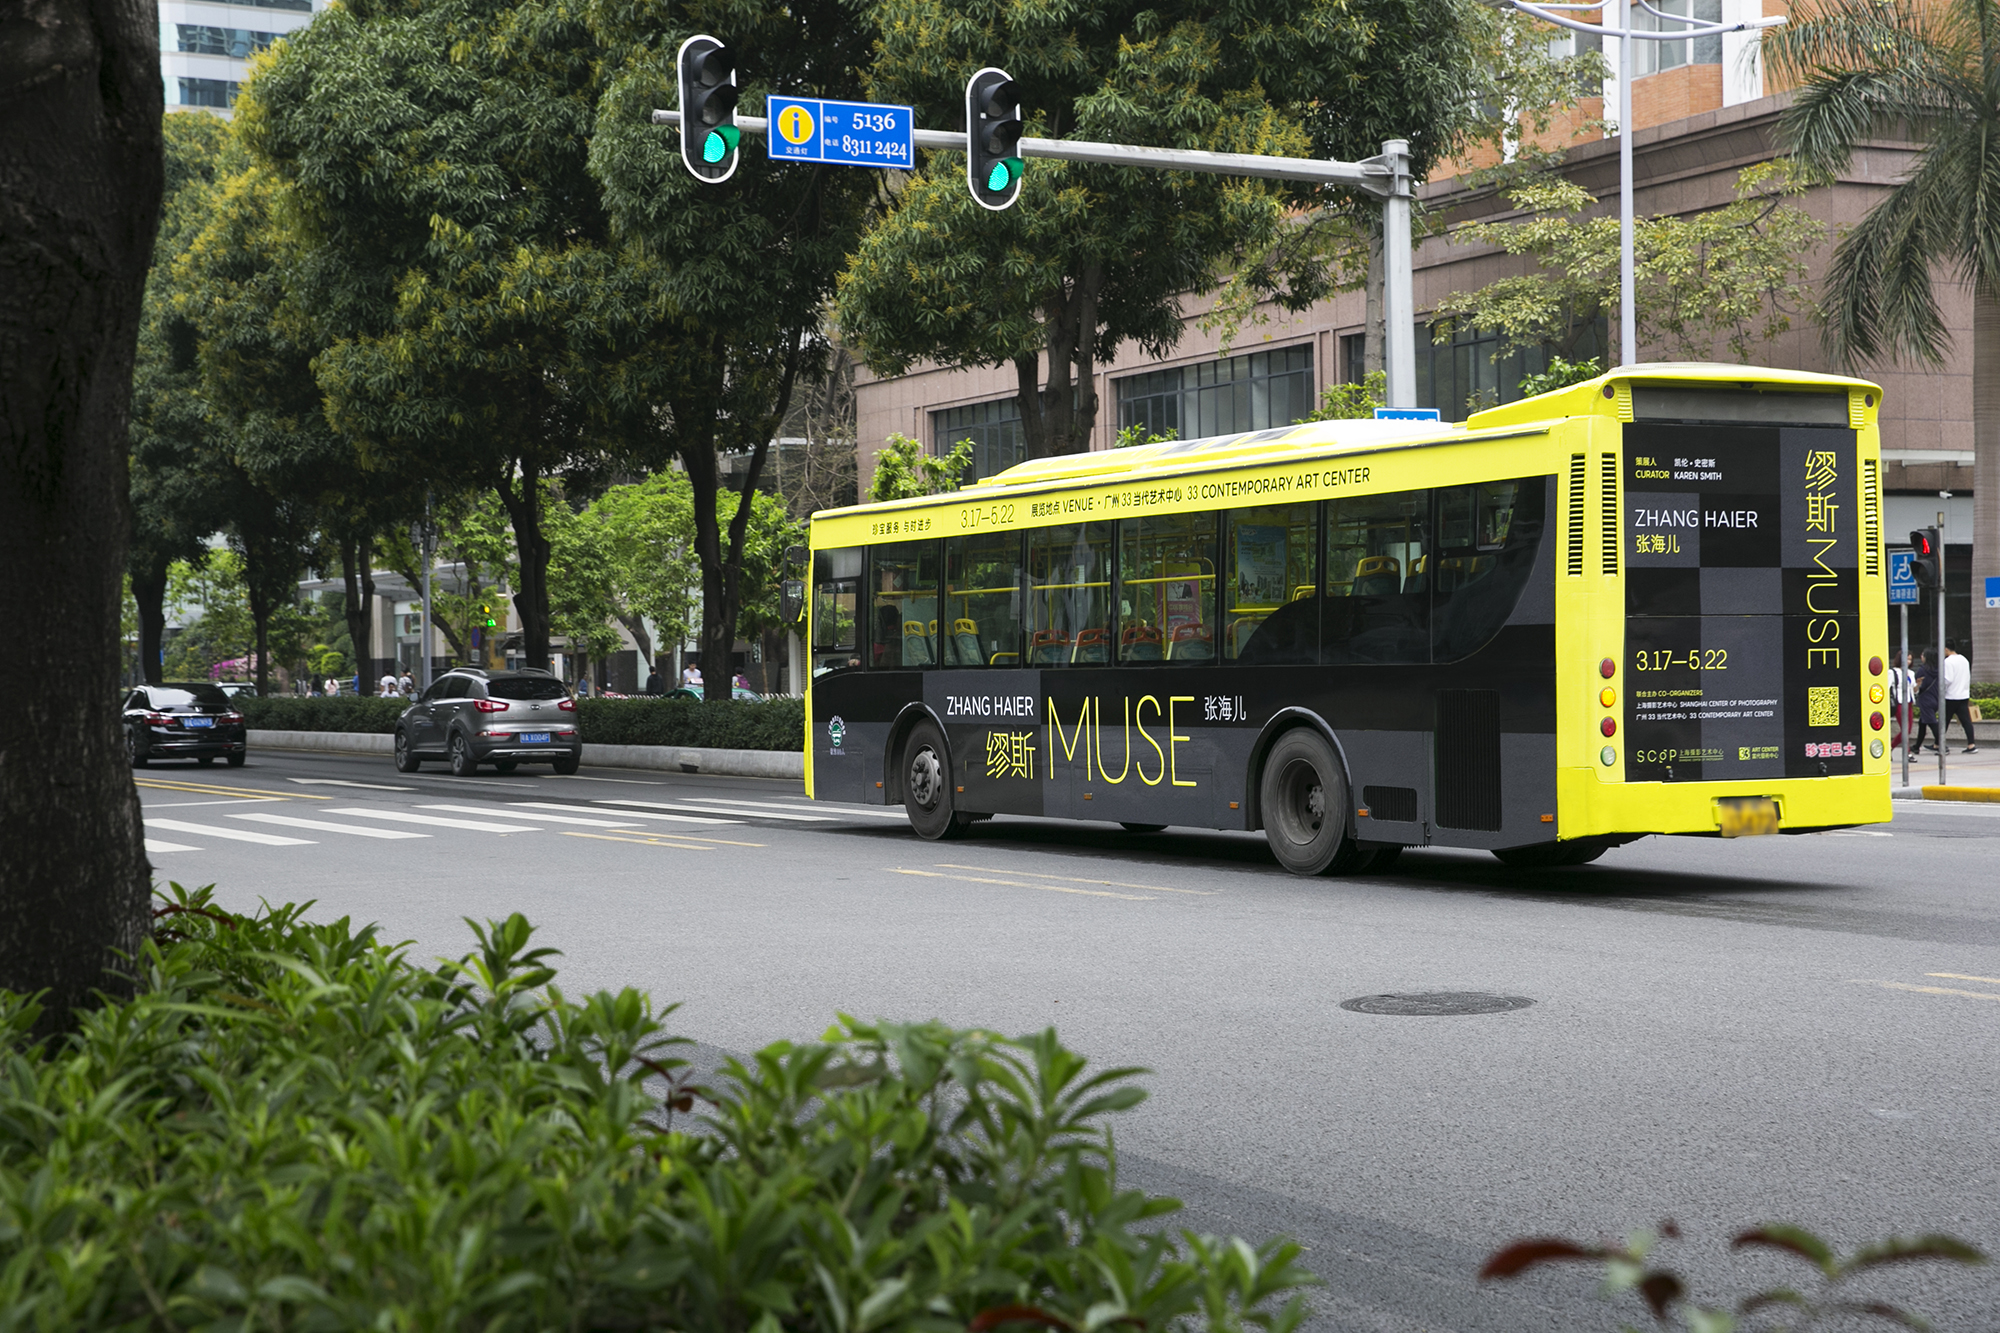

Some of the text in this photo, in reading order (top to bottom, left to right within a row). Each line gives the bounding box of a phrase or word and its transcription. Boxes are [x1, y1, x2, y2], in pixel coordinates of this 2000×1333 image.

[852, 112, 896, 132] 5136
[785, 146, 808, 156] 交通灯
[842, 134, 872, 157] 8311
[875, 141, 907, 160] 2424
[1635, 457, 1658, 467] 策展人
[1635, 470, 1722, 481] CURATOR KAREN SMITH
[1031, 466, 1371, 518] 展览地点 VENUE 广州 33 当代艺术中心 33 CONTEMPORARY ART CENTER
[1805, 449, 1839, 533] 缪斯
[903, 518, 932, 533] 与时进步
[1634, 509, 1758, 528] ZHANG HAIER
[1636, 534, 1680, 554] 张海儿
[1806, 539, 1840, 669] MUSE
[946, 695, 1034, 717] ZHANG HAIER
[1204, 695, 1247, 722] 张海儿
[1680, 700, 1708, 708] SHANGHAI
[1737, 699, 1778, 707] PHOTOGRAPHY
[1698, 711, 1741, 719] CONTEMPORARY
[1753, 710, 1774, 718] CENTER
[1048, 695, 1198, 787] MUSE
[1805, 741, 1856, 757] 珍宝巴士
[986, 730, 1036, 780] 缪斯
[1738, 746, 1751, 760] 33
